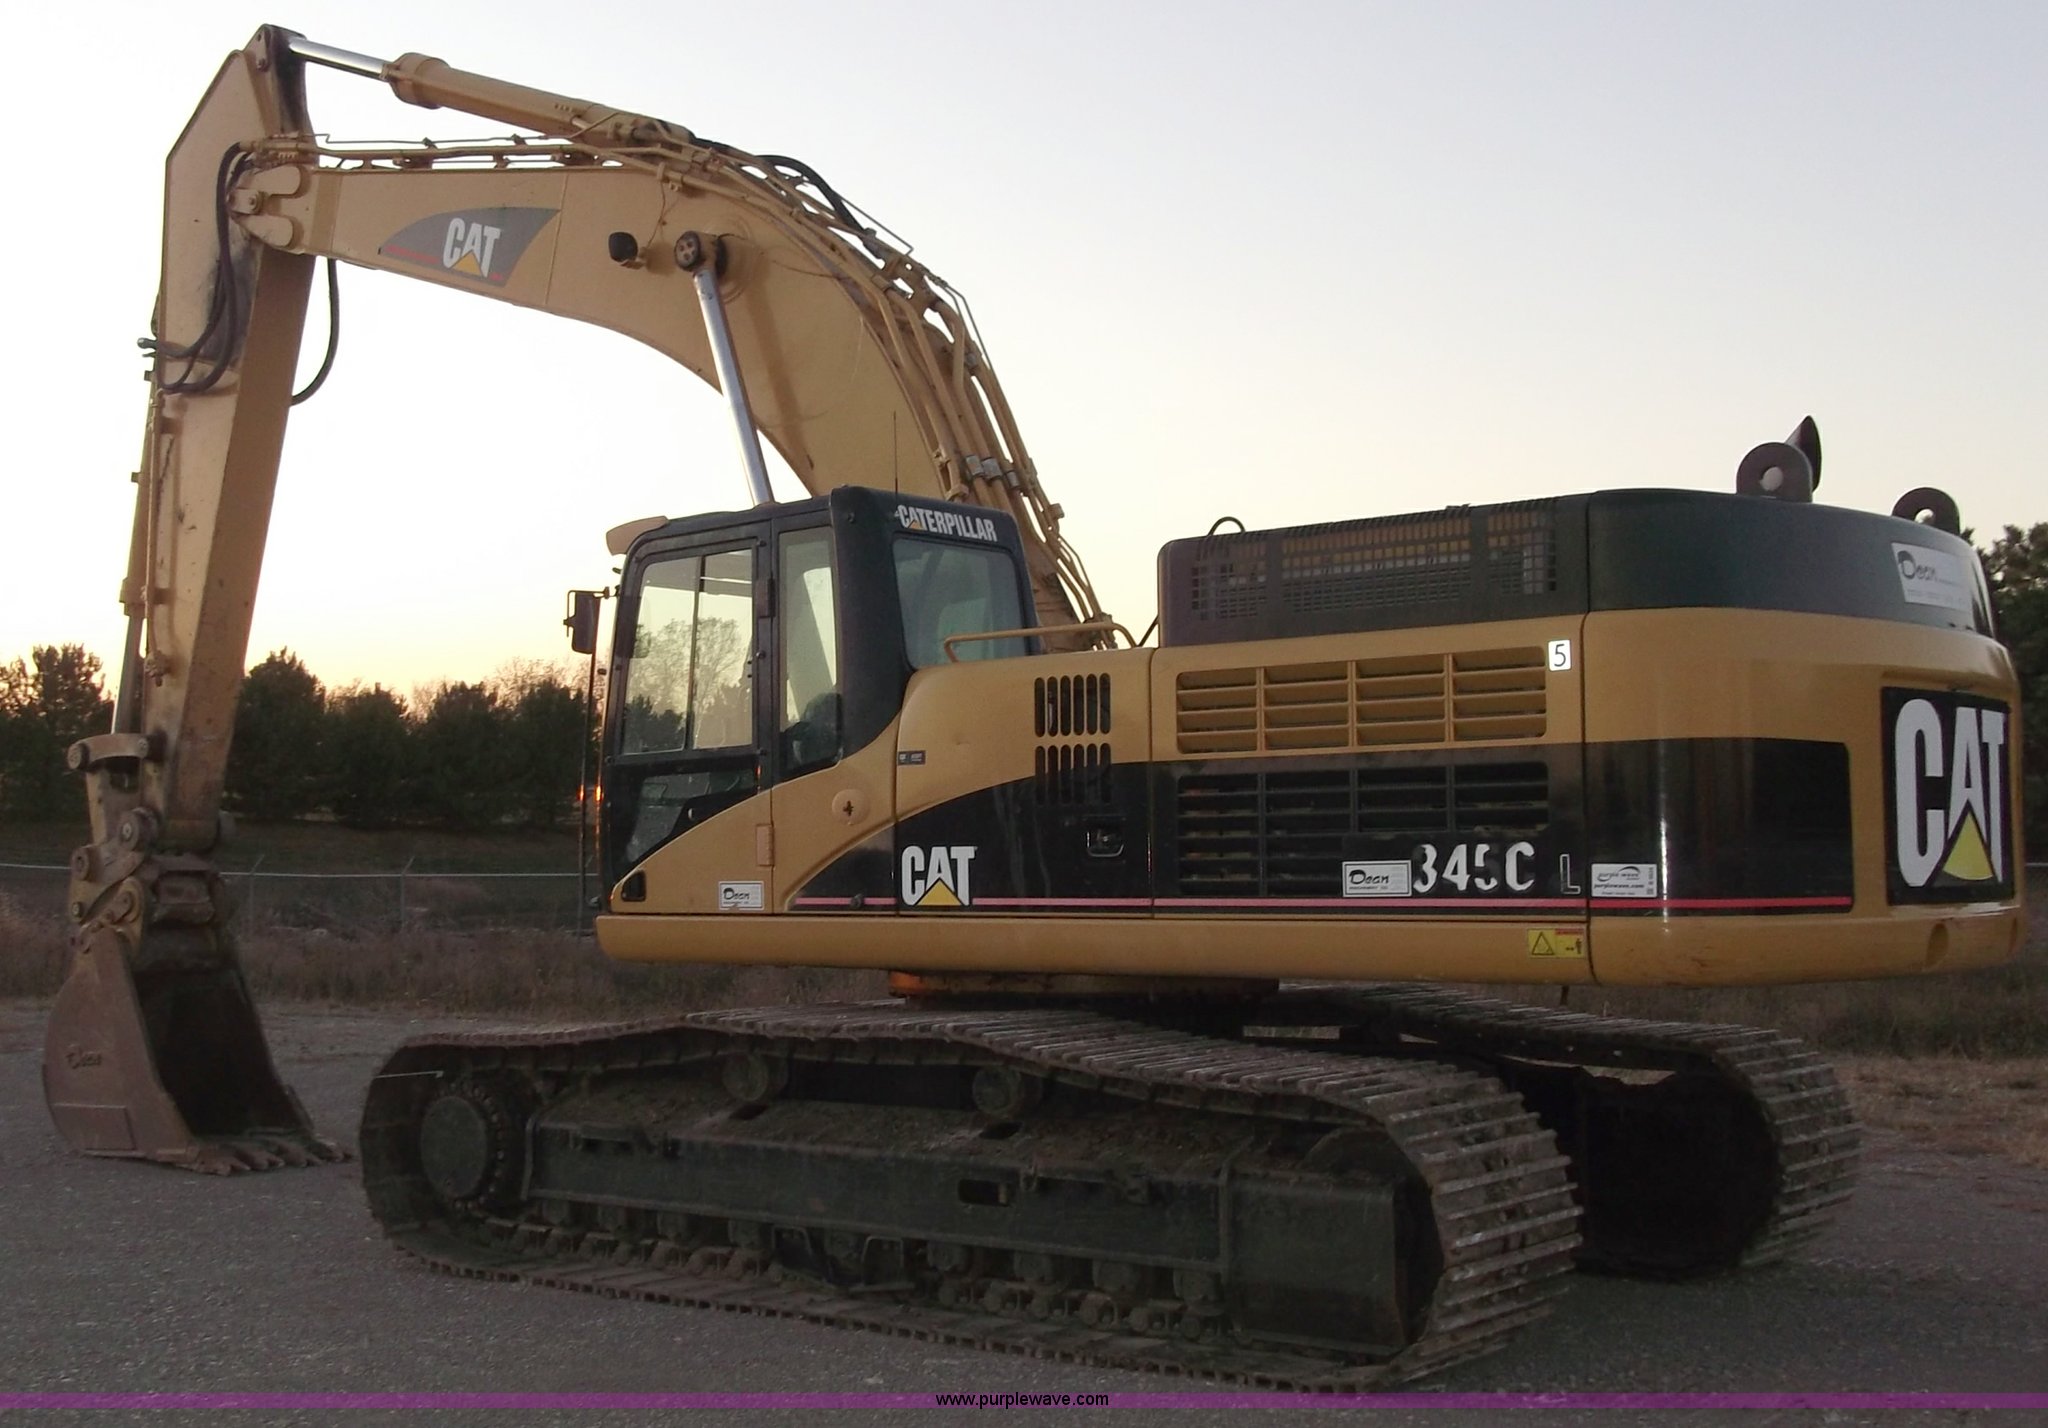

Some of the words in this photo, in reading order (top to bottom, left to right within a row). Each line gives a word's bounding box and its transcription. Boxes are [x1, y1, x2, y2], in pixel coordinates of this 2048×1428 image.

[443, 217, 501, 278] CAT
[897, 504, 998, 542] CATERPILLAR
[1553, 643, 1566, 667] 5
[1895, 698, 2005, 887] CAT
[901, 845, 978, 907] CAT
[1349, 869, 1390, 885] Dean
[1413, 841, 1535, 893] 345C
[1559, 853, 1581, 895] L
